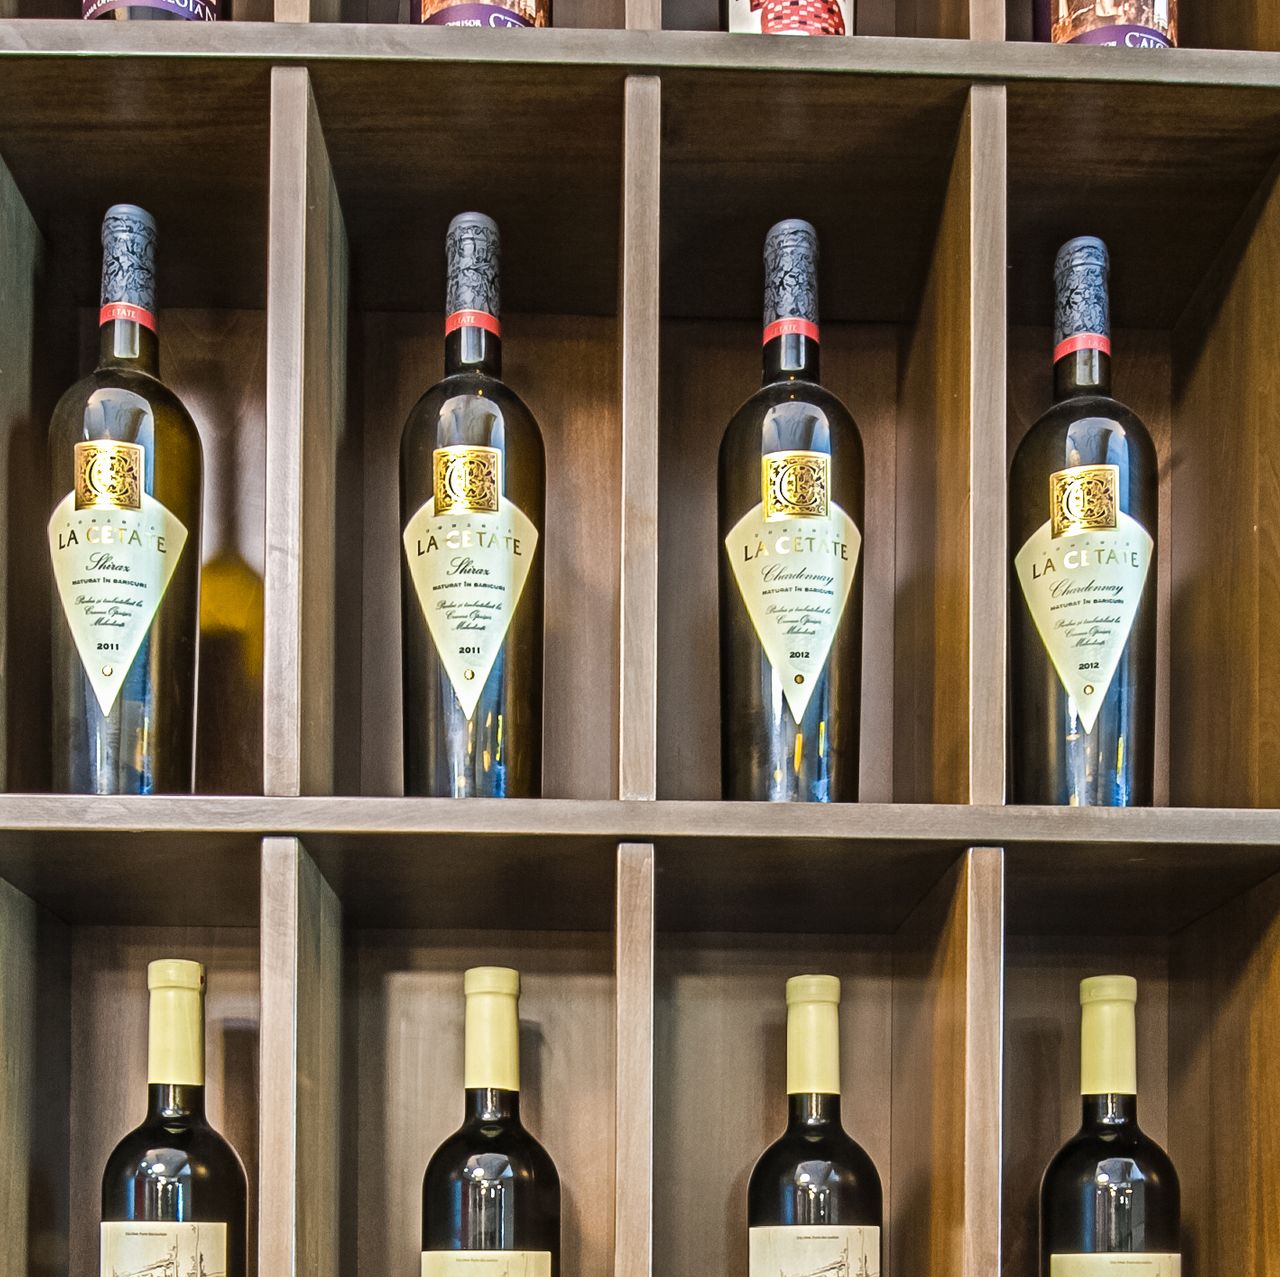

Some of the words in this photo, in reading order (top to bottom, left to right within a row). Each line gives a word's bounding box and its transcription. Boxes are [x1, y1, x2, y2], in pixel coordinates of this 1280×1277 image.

[59, 529, 79, 550] LA
[417, 534, 438, 556] LA
[744, 541, 769, 561] LA
[85, 552, 130, 572] Shiraz
[446, 556, 490, 576] Shiraz
[1032, 557, 1056, 580] LA
[761, 564, 834, 585] Chardonnay
[1049, 579, 1124, 599] Chardonnay
[789, 651, 810, 659] 2012
[1078, 662, 1099, 670] 2012
